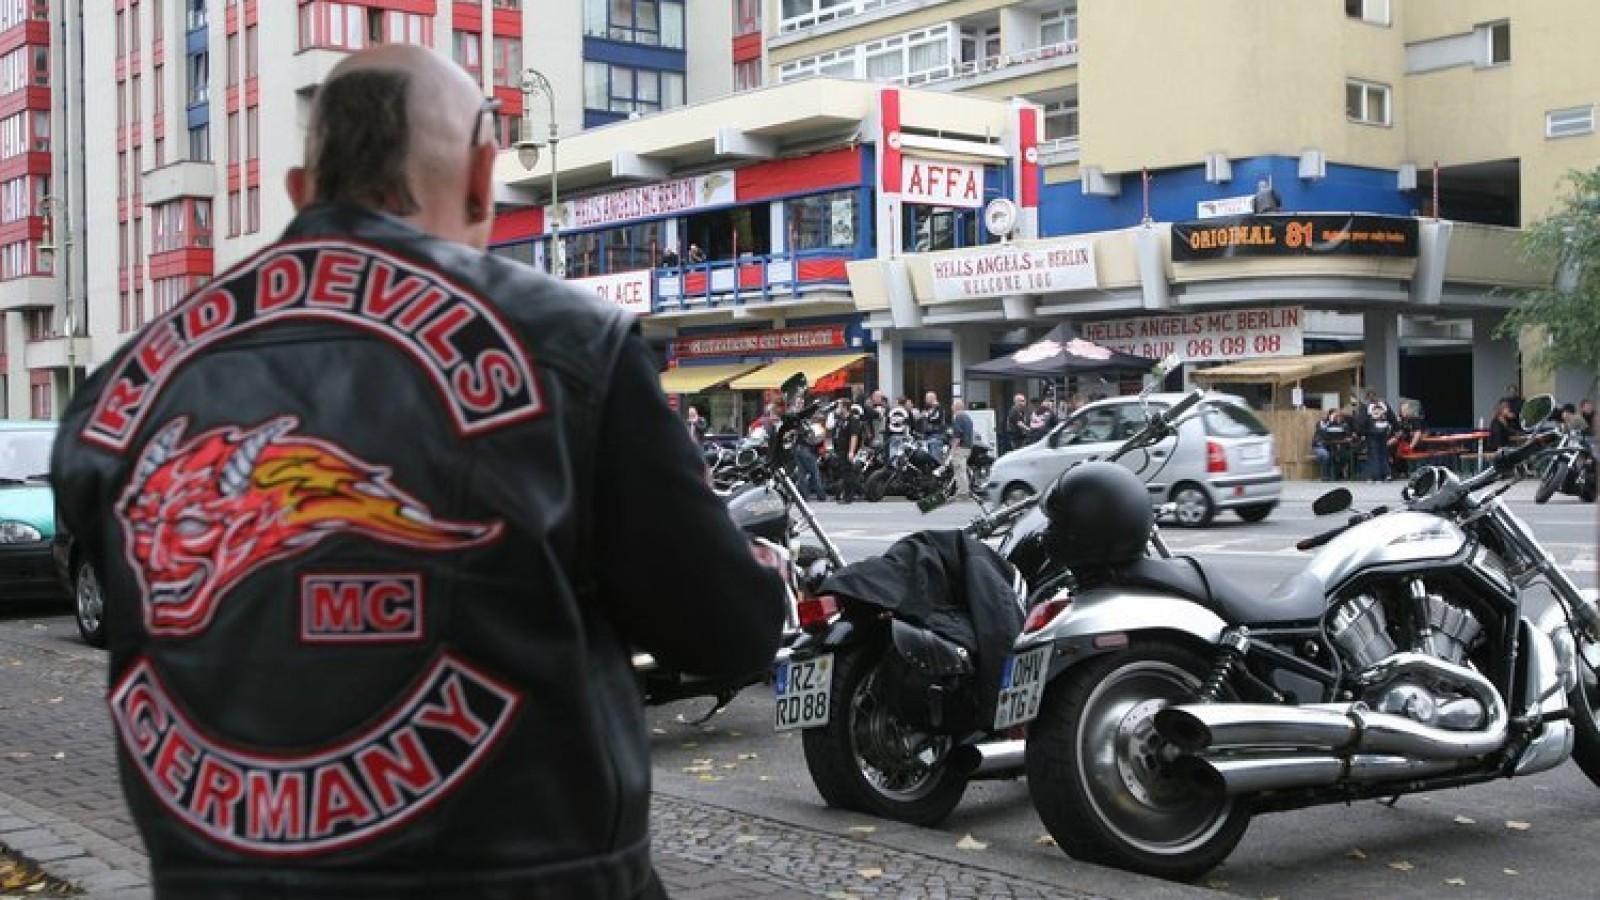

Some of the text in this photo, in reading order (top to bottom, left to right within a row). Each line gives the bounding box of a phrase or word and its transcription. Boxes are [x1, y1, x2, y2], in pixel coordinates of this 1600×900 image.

[908, 164, 978, 200] AFFA
[1190, 225, 1276, 250] ORIGINAL
[1285, 221, 1312, 248] 81
[934, 260, 973, 279] HELLS
[977, 252, 1032, 275] ANGELS
[1048, 249, 1089, 268] BERLIN
[964, 275, 1023, 295] WELCOME
[99, 249, 523, 433] RED DEVILS
[1087, 308, 1298, 341] HELLS ANGELS MC BERLIN
[1143, 341, 1174, 358] RUN
[1187, 338, 1213, 358] 06
[1220, 335, 1246, 355] 09
[1253, 334, 1281, 352] 08
[312, 581, 412, 632] MC
[789, 663, 815, 693] RZ
[776, 692, 826, 727] RD88
[124, 672, 489, 841] GERMANY
